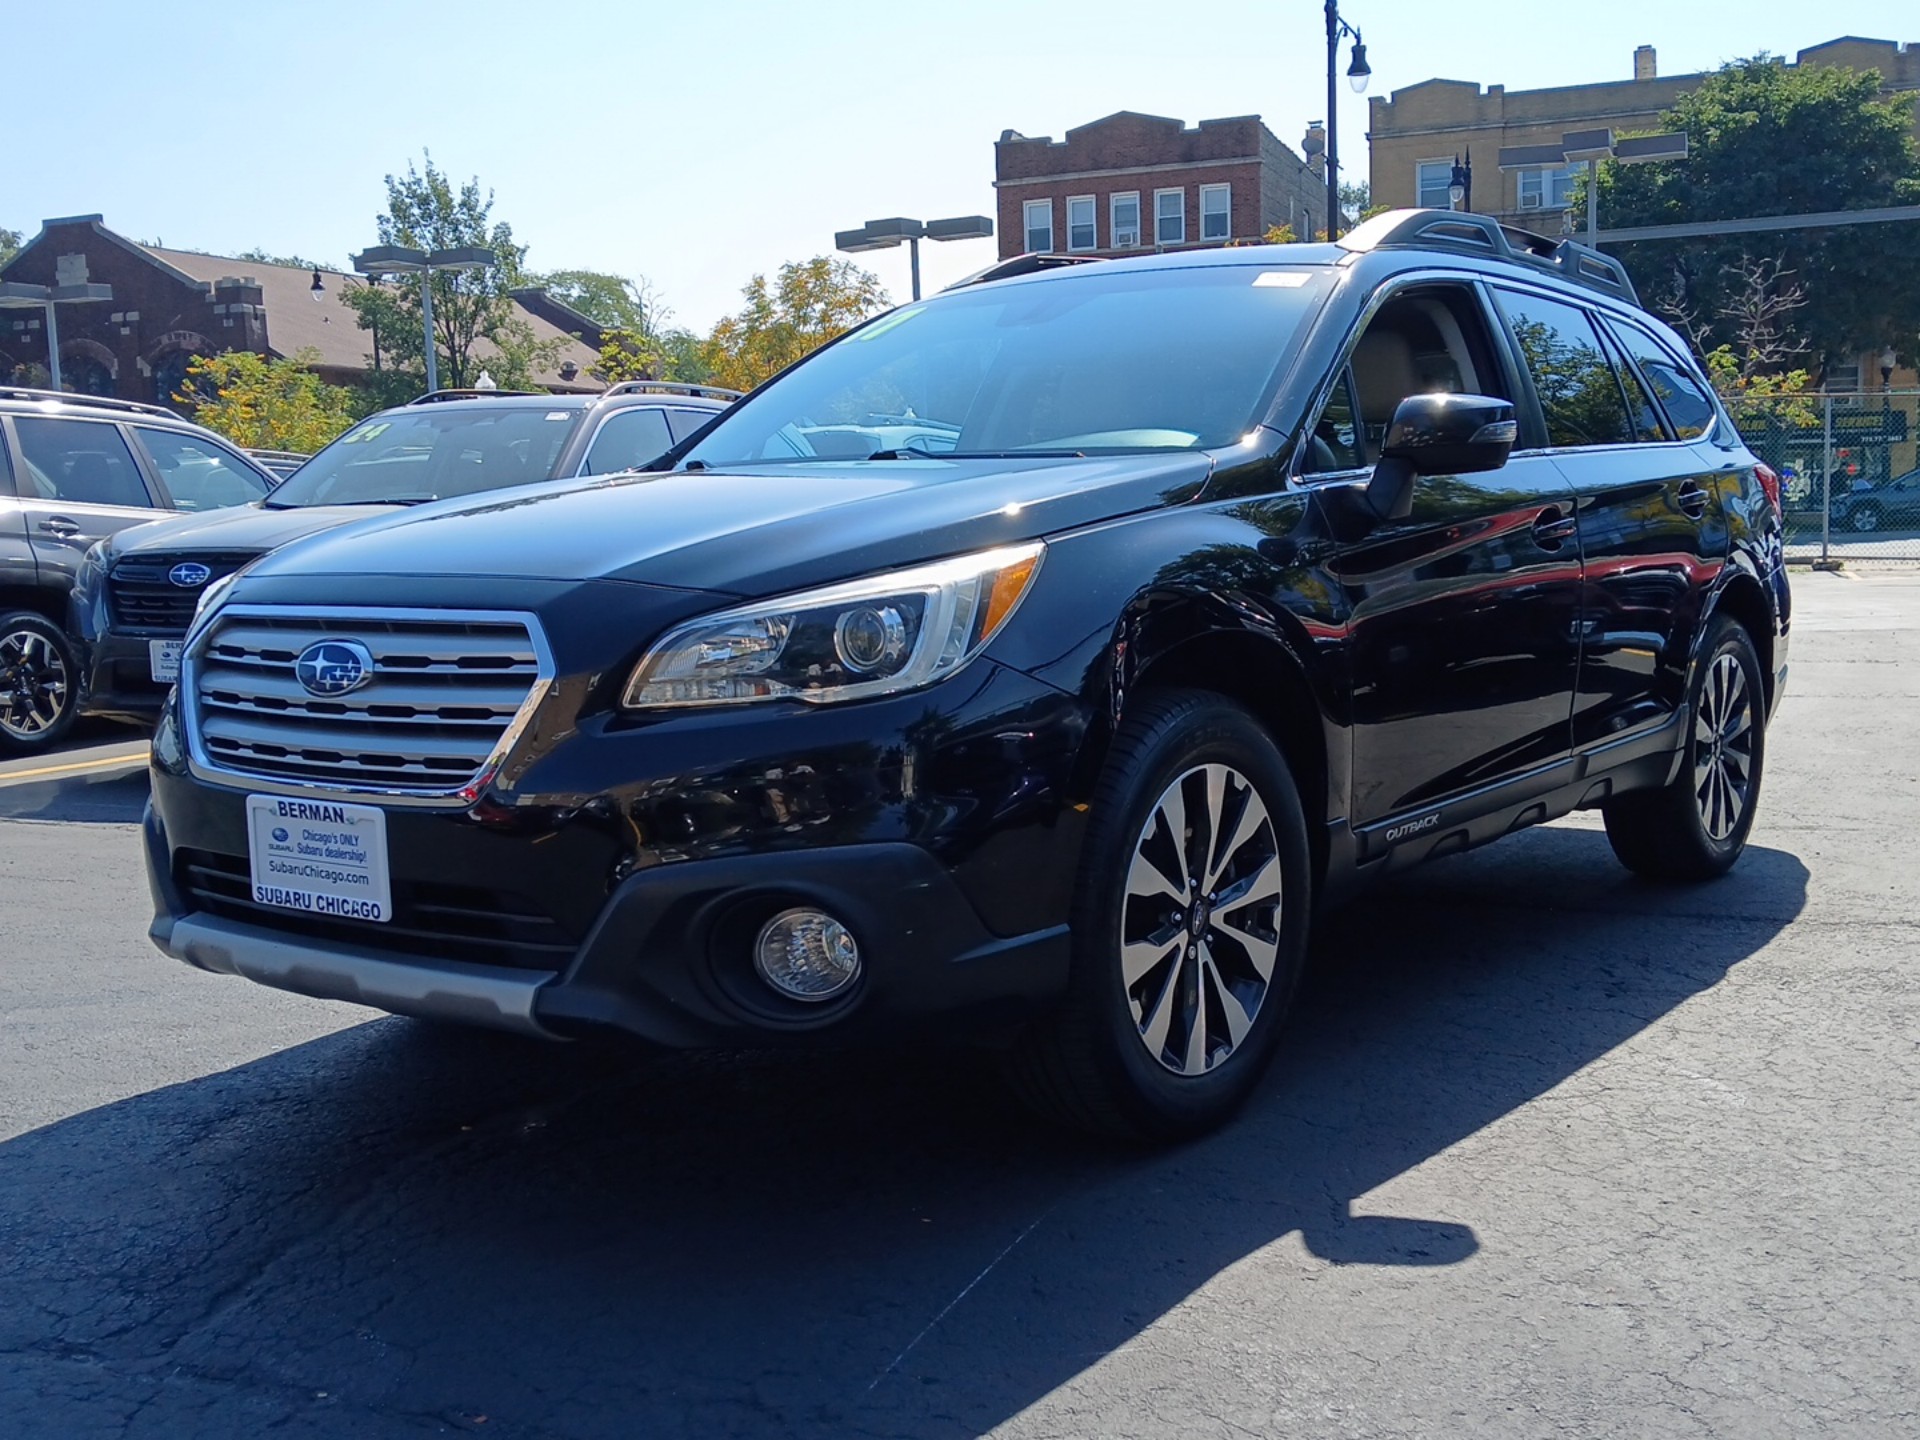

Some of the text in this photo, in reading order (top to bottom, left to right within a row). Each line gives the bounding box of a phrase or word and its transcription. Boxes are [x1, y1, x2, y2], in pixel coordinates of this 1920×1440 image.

[343, 423, 391, 444] 24
[277, 800, 345, 824] BERMAN
[302, 828, 359, 847] Chicago's ONLY
[1386, 813, 1439, 842] OUTBACK
[297, 842, 367, 864] Subaru dealership!
[269, 860, 369, 886] SubaruChicago.com
[256, 886, 381, 920] SUBARU CHICAGO
